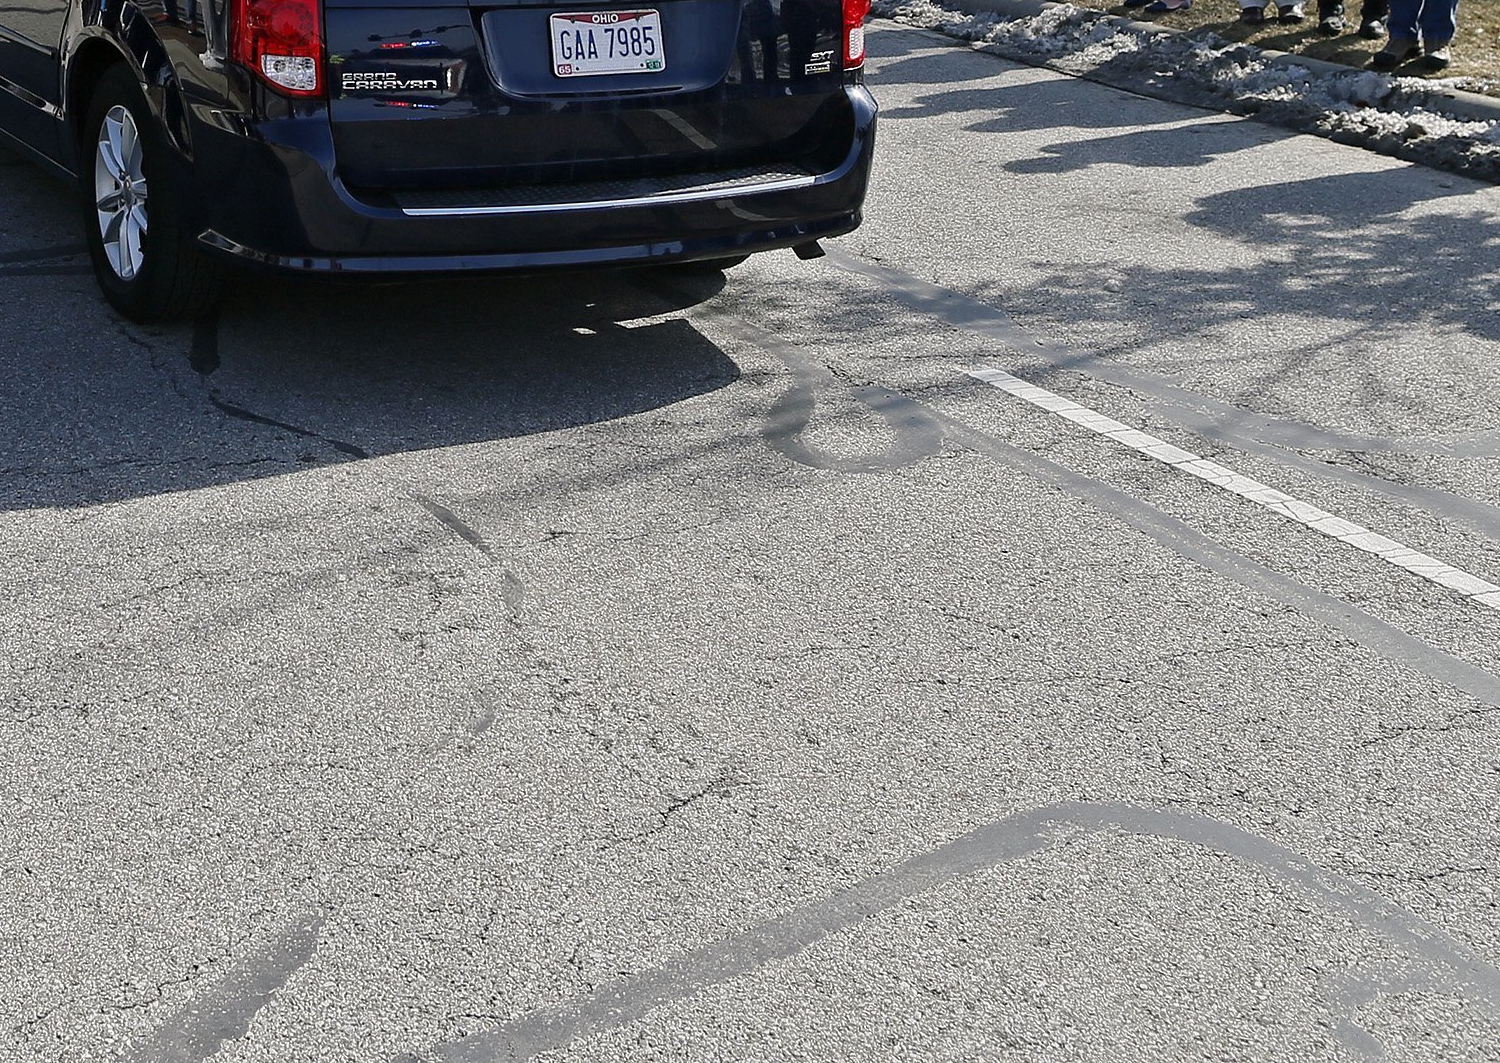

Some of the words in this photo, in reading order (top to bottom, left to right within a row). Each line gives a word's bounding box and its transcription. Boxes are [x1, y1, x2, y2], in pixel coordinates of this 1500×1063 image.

[591, 13, 619, 24] OHIO
[560, 29, 598, 60] GAA
[604, 26, 655, 58] 7985
[558, 65, 571, 74] 65
[342, 72, 397, 81] GRAND
[342, 79, 438, 90] CARAVAN
